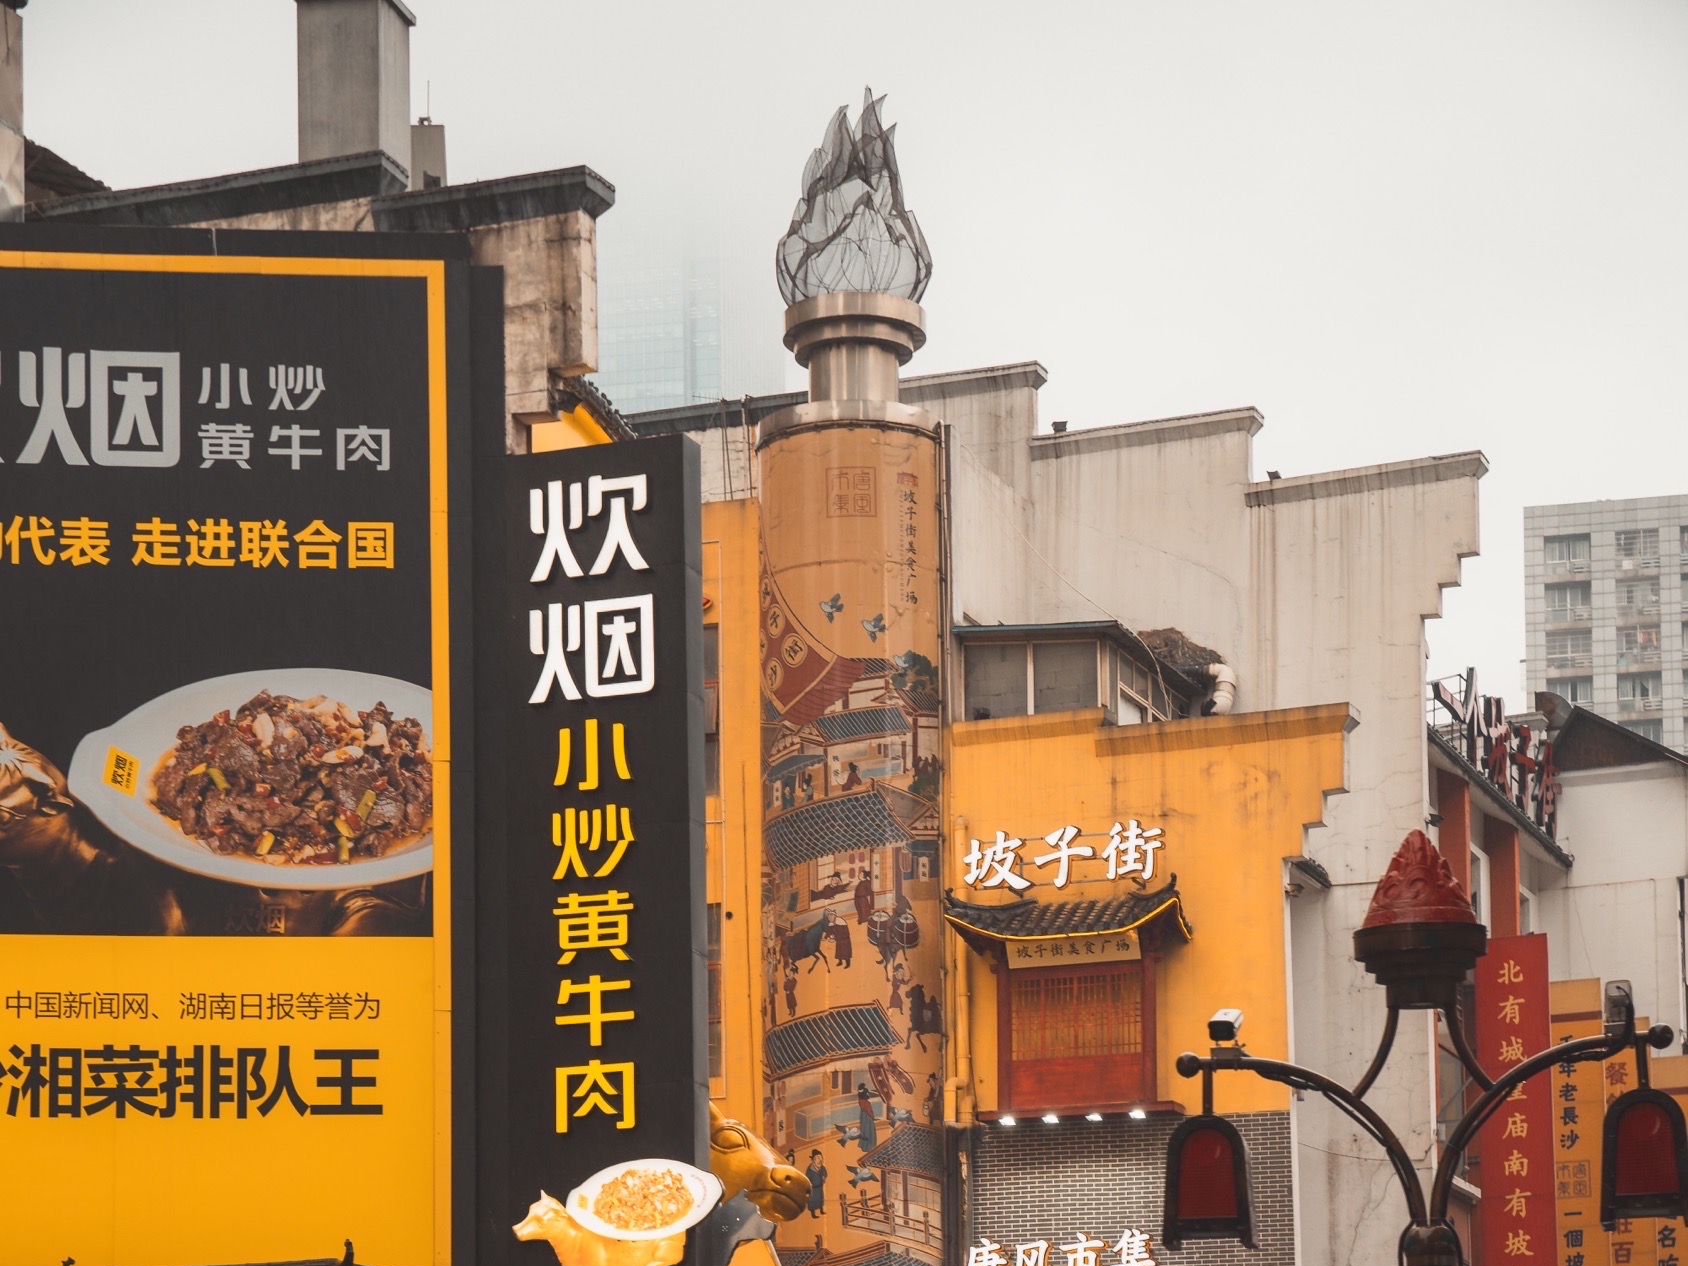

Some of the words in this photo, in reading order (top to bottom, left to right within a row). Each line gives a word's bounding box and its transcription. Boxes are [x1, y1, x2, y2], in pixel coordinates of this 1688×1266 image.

[0, 347, 180, 467] 烟
[198, 363, 326, 411] 小炒
[198, 423, 391, 471] 黄牛肉
[0, 515, 111, 566] 代表
[132, 517, 394, 569] 走进联合国
[904, 490, 918, 605] 坡子街美食广场
[963, 820, 1164, 890] 坡子街
[1016, 940, 1131, 960] 坡子街美食广场
[5, 990, 381, 1021] 中国新闻网、湖南日报等誉为
[0, 1043, 383, 1119] 湘菜排队王
